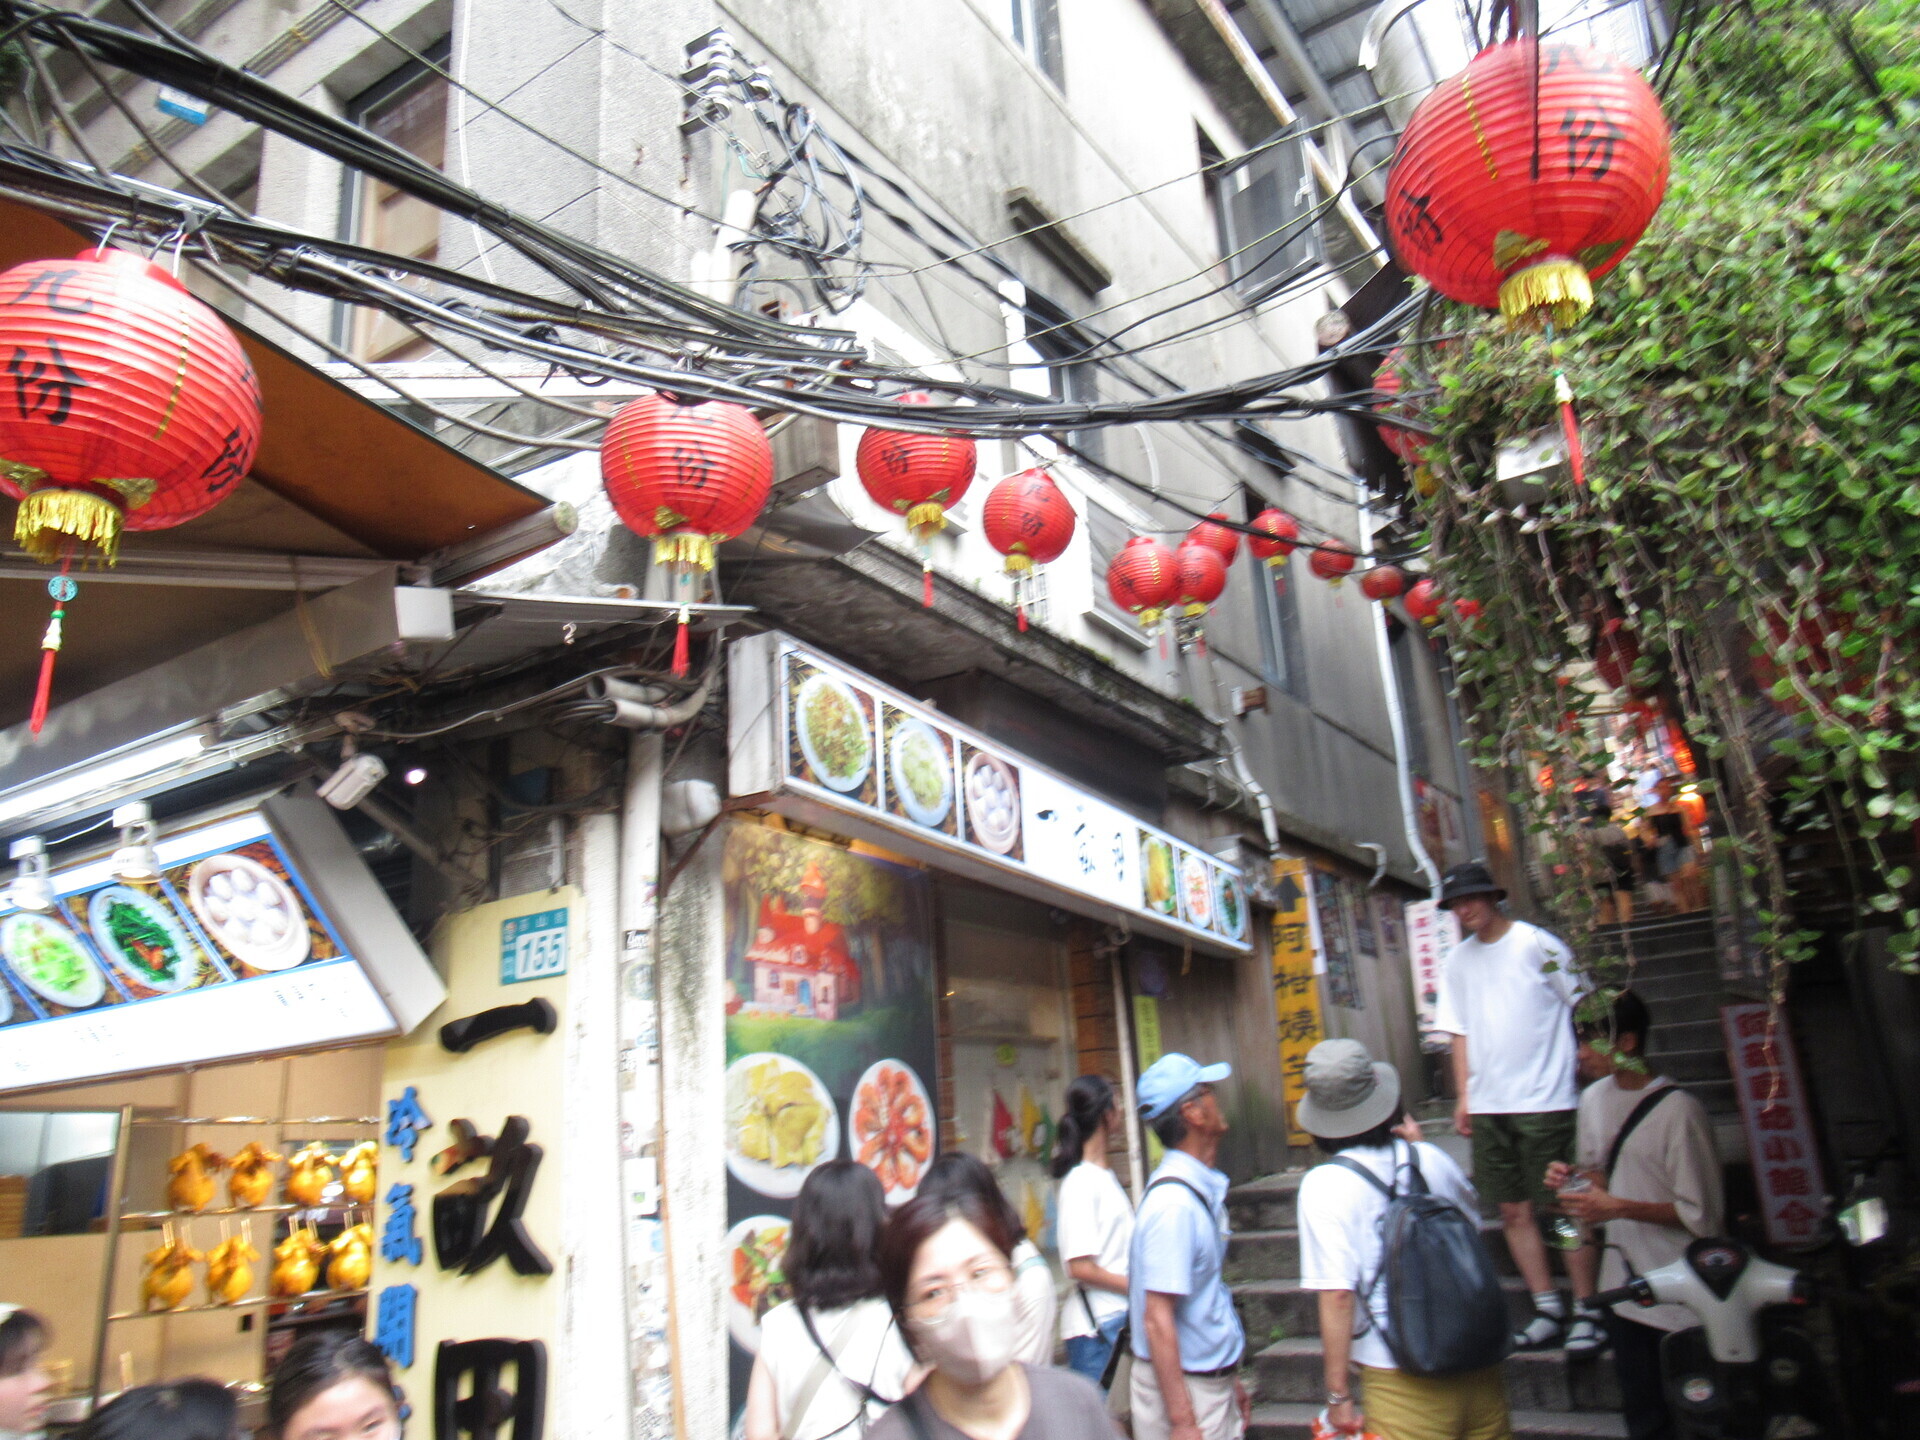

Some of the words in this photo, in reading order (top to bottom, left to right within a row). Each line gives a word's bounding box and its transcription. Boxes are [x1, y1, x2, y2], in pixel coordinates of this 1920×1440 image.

[6, 269, 92, 425] 九份
[519, 932, 564, 975] 155
[374, 1086, 433, 1420] 冷氣開
